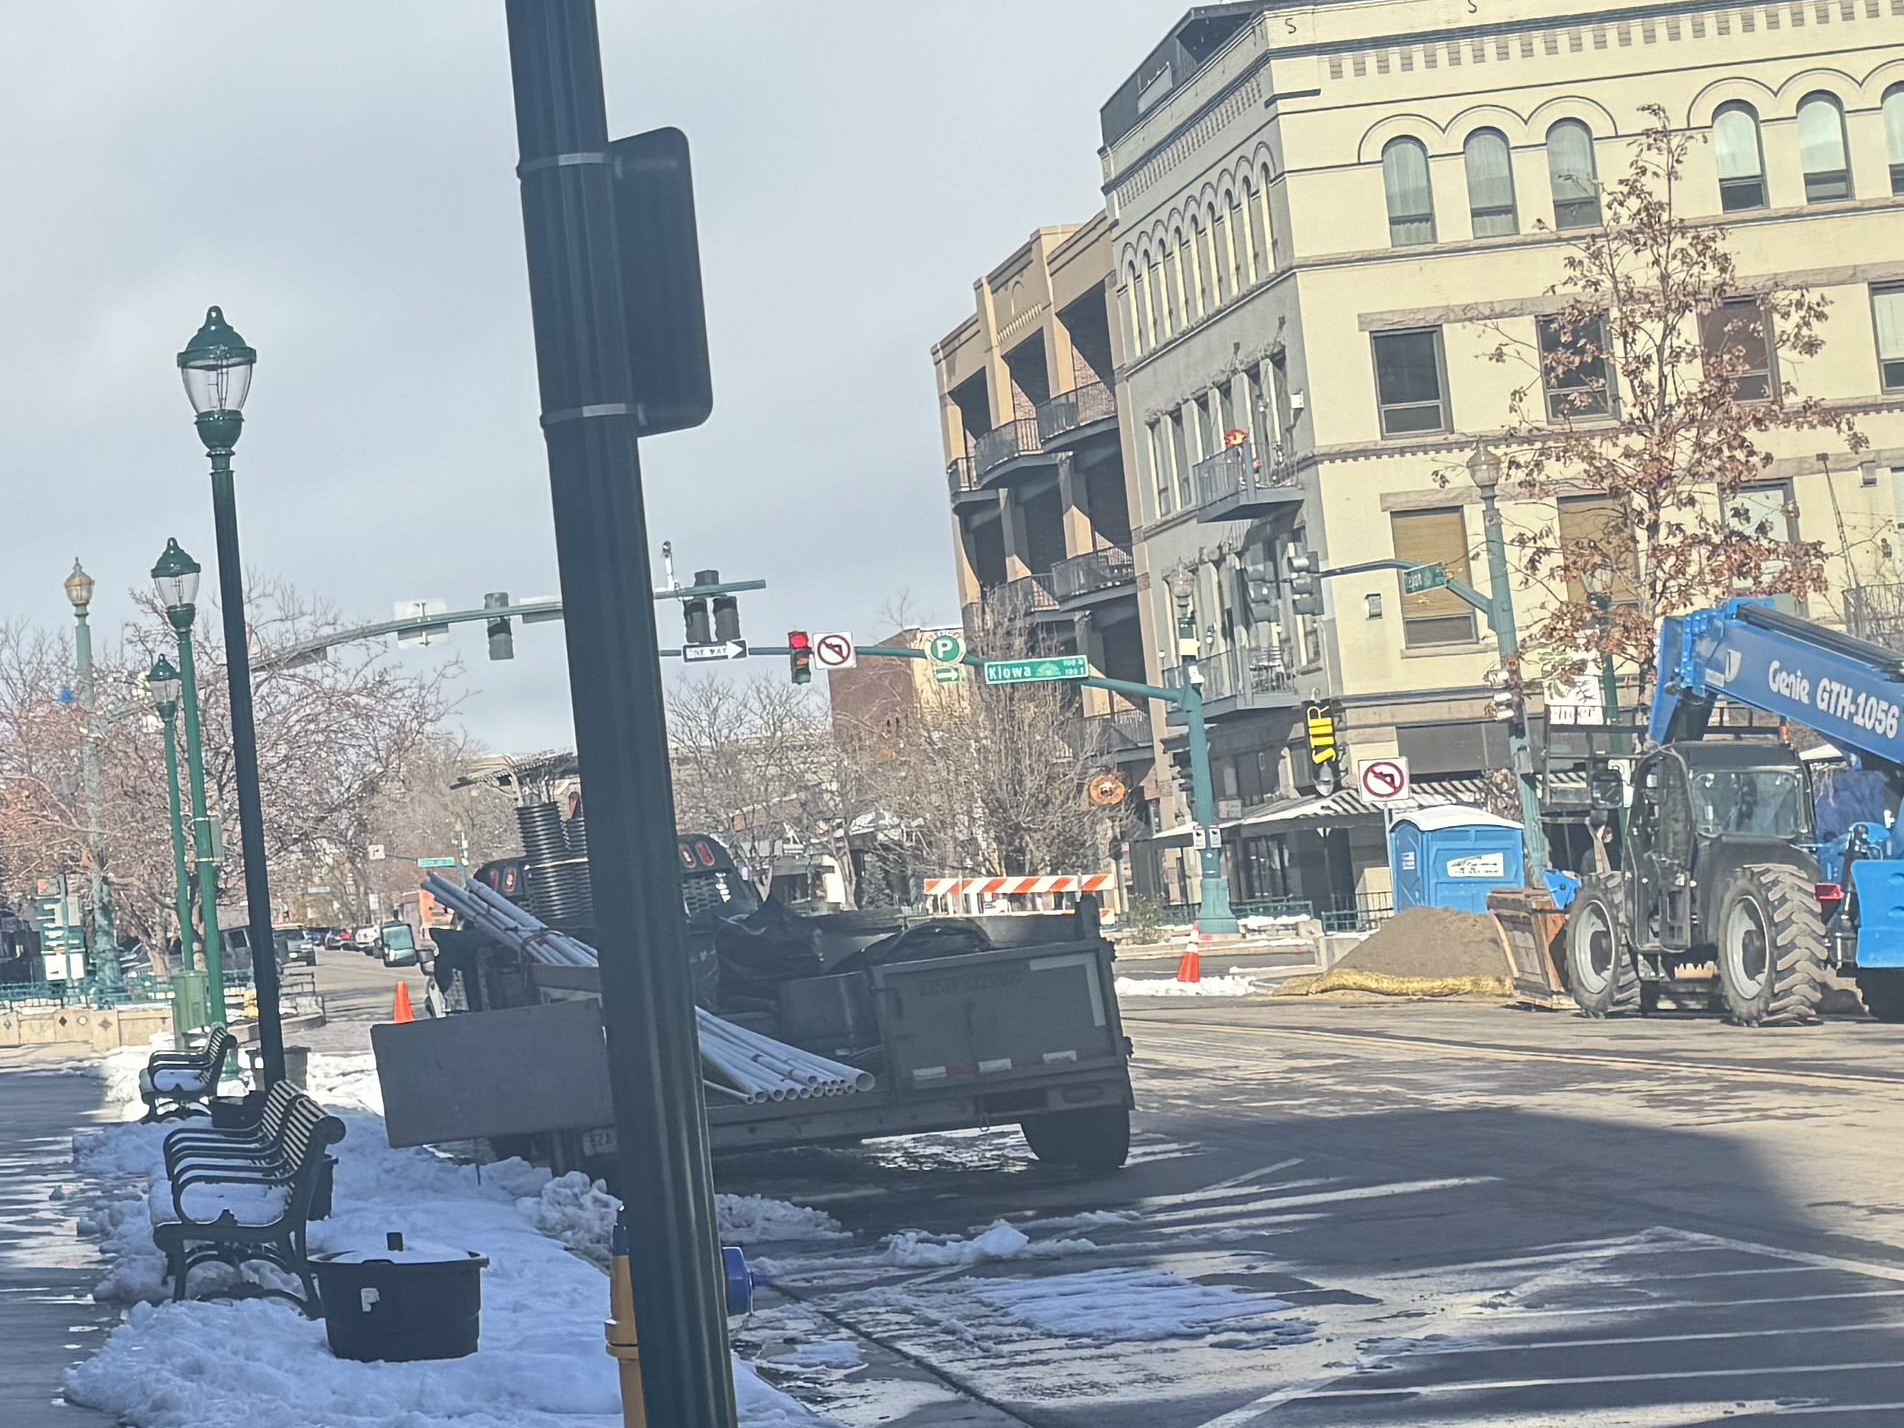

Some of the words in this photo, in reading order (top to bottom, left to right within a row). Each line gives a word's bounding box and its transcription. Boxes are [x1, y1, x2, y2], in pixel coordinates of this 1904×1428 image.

[936, 639, 953, 659] P
[988, 665, 1032, 681] Kiowa
[1768, 660, 1810, 704] Genie
[1816, 677, 1901, 739] GTH-1056
[1306, 705, 1337, 765] STIR
